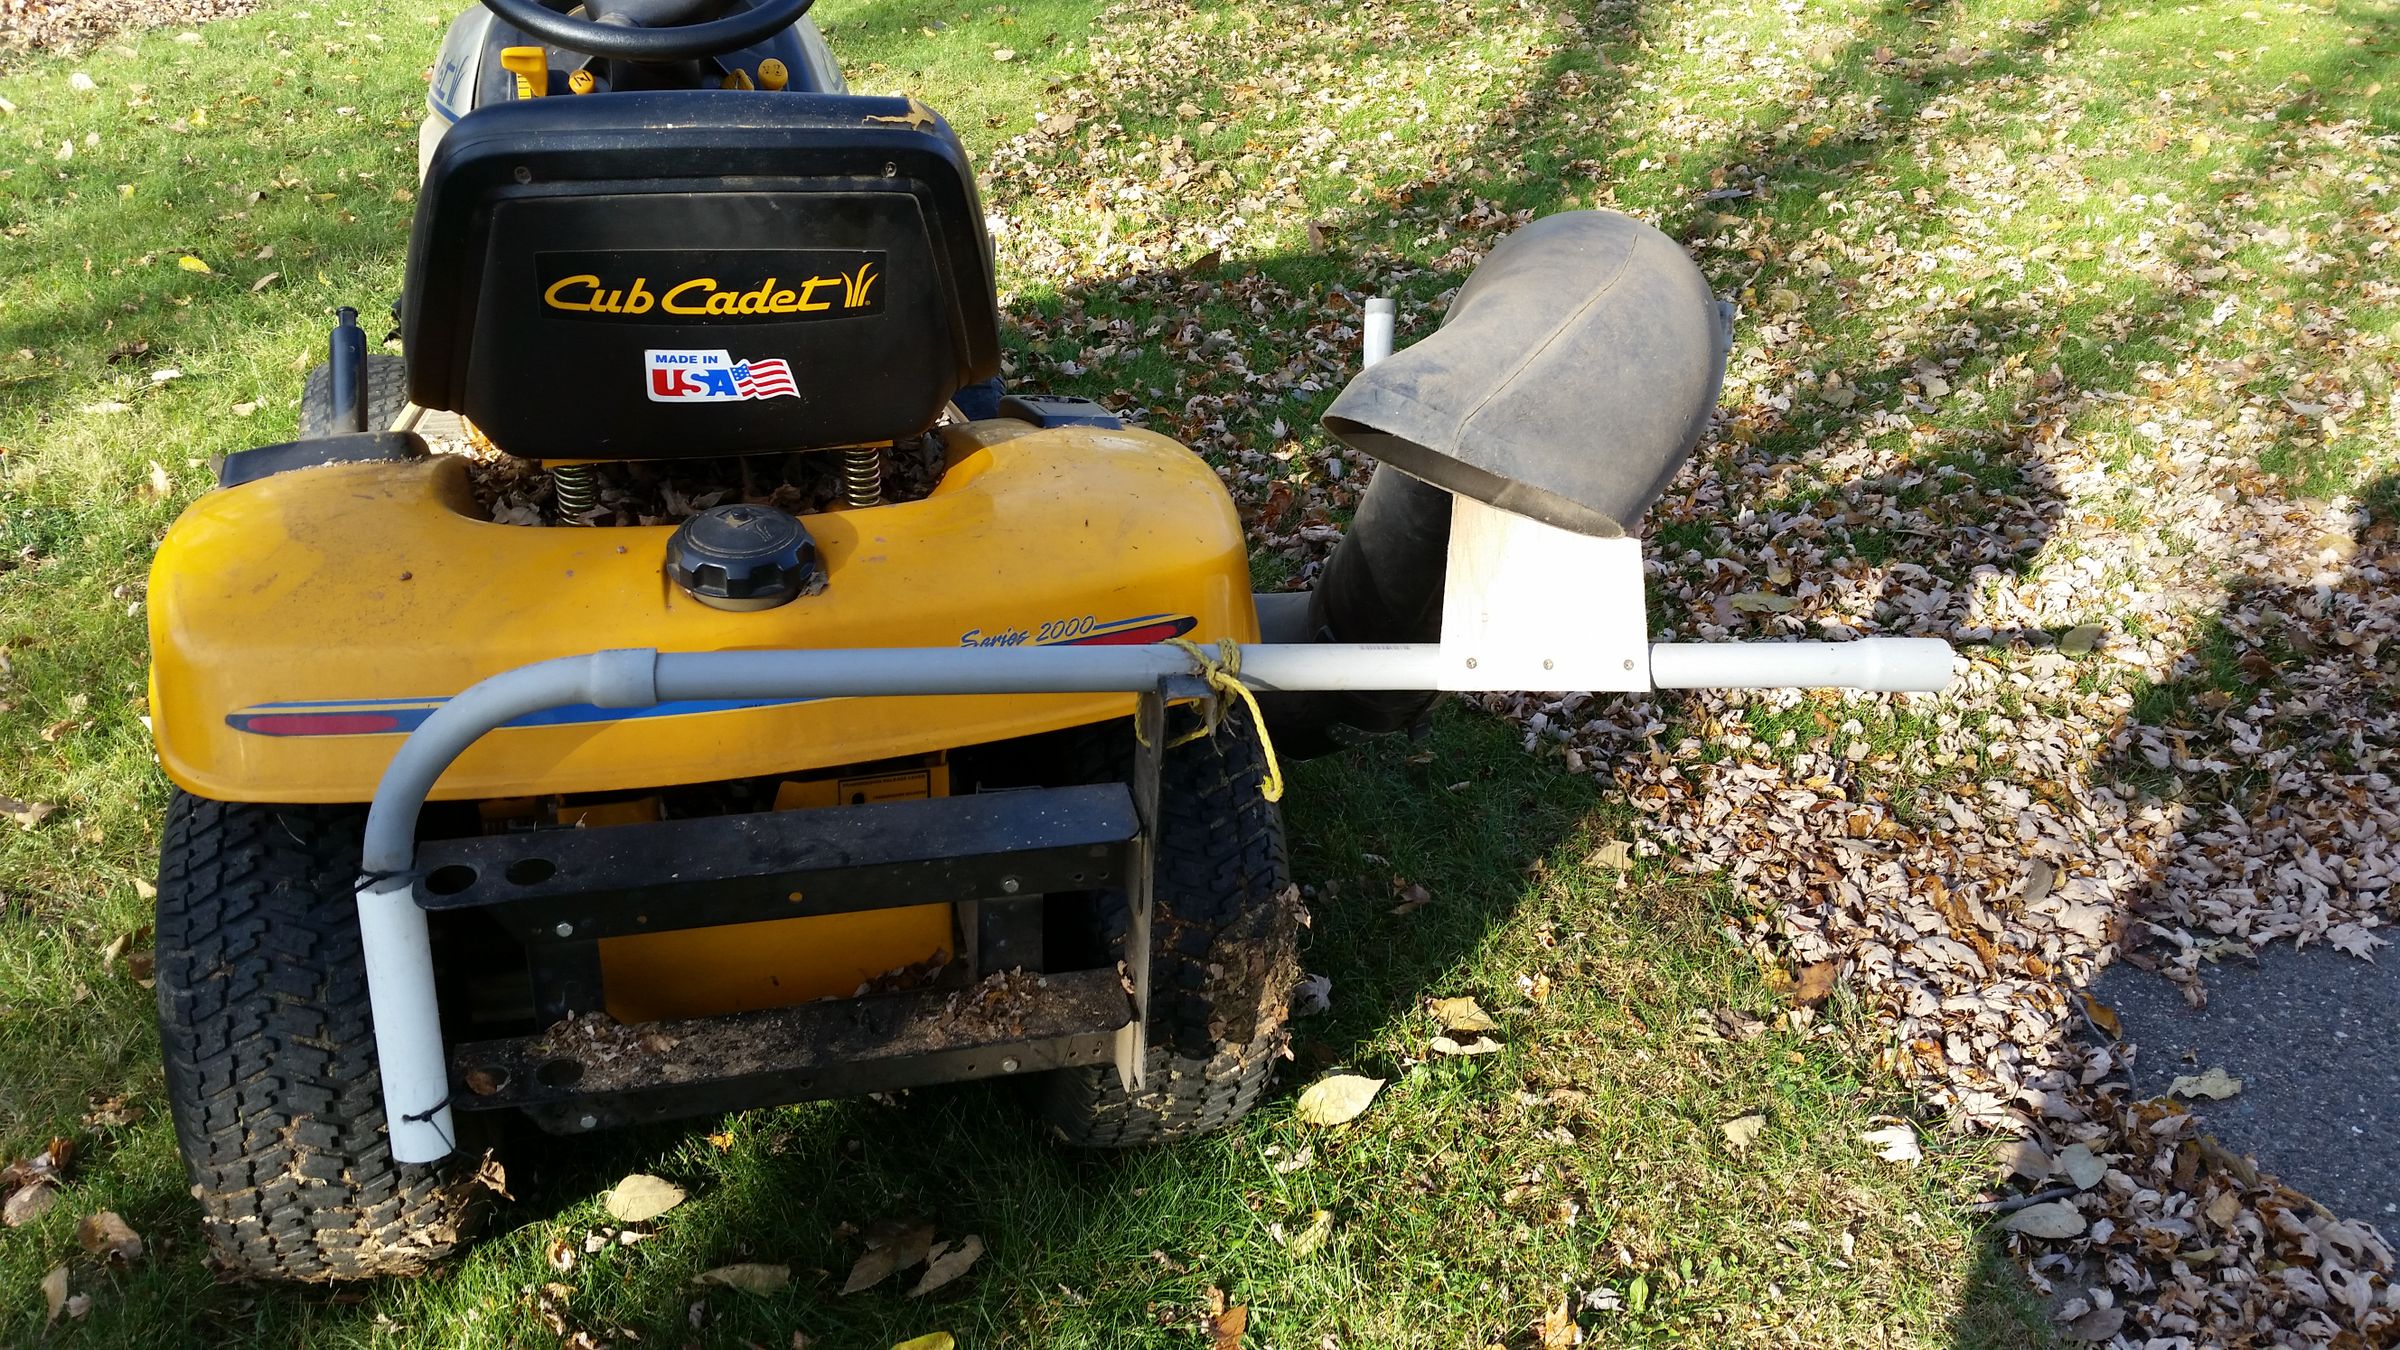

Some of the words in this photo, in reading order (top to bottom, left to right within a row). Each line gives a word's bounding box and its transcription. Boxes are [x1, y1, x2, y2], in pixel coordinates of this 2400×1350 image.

[544, 275, 655, 313] Cub
[661, 276, 842, 315] Cadet
[655, 355, 698, 364] MADE
[702, 355, 718, 364] IN
[652, 369, 738, 396] USA
[961, 628, 1031, 647] Series
[1036, 615, 1095, 642] 2000
